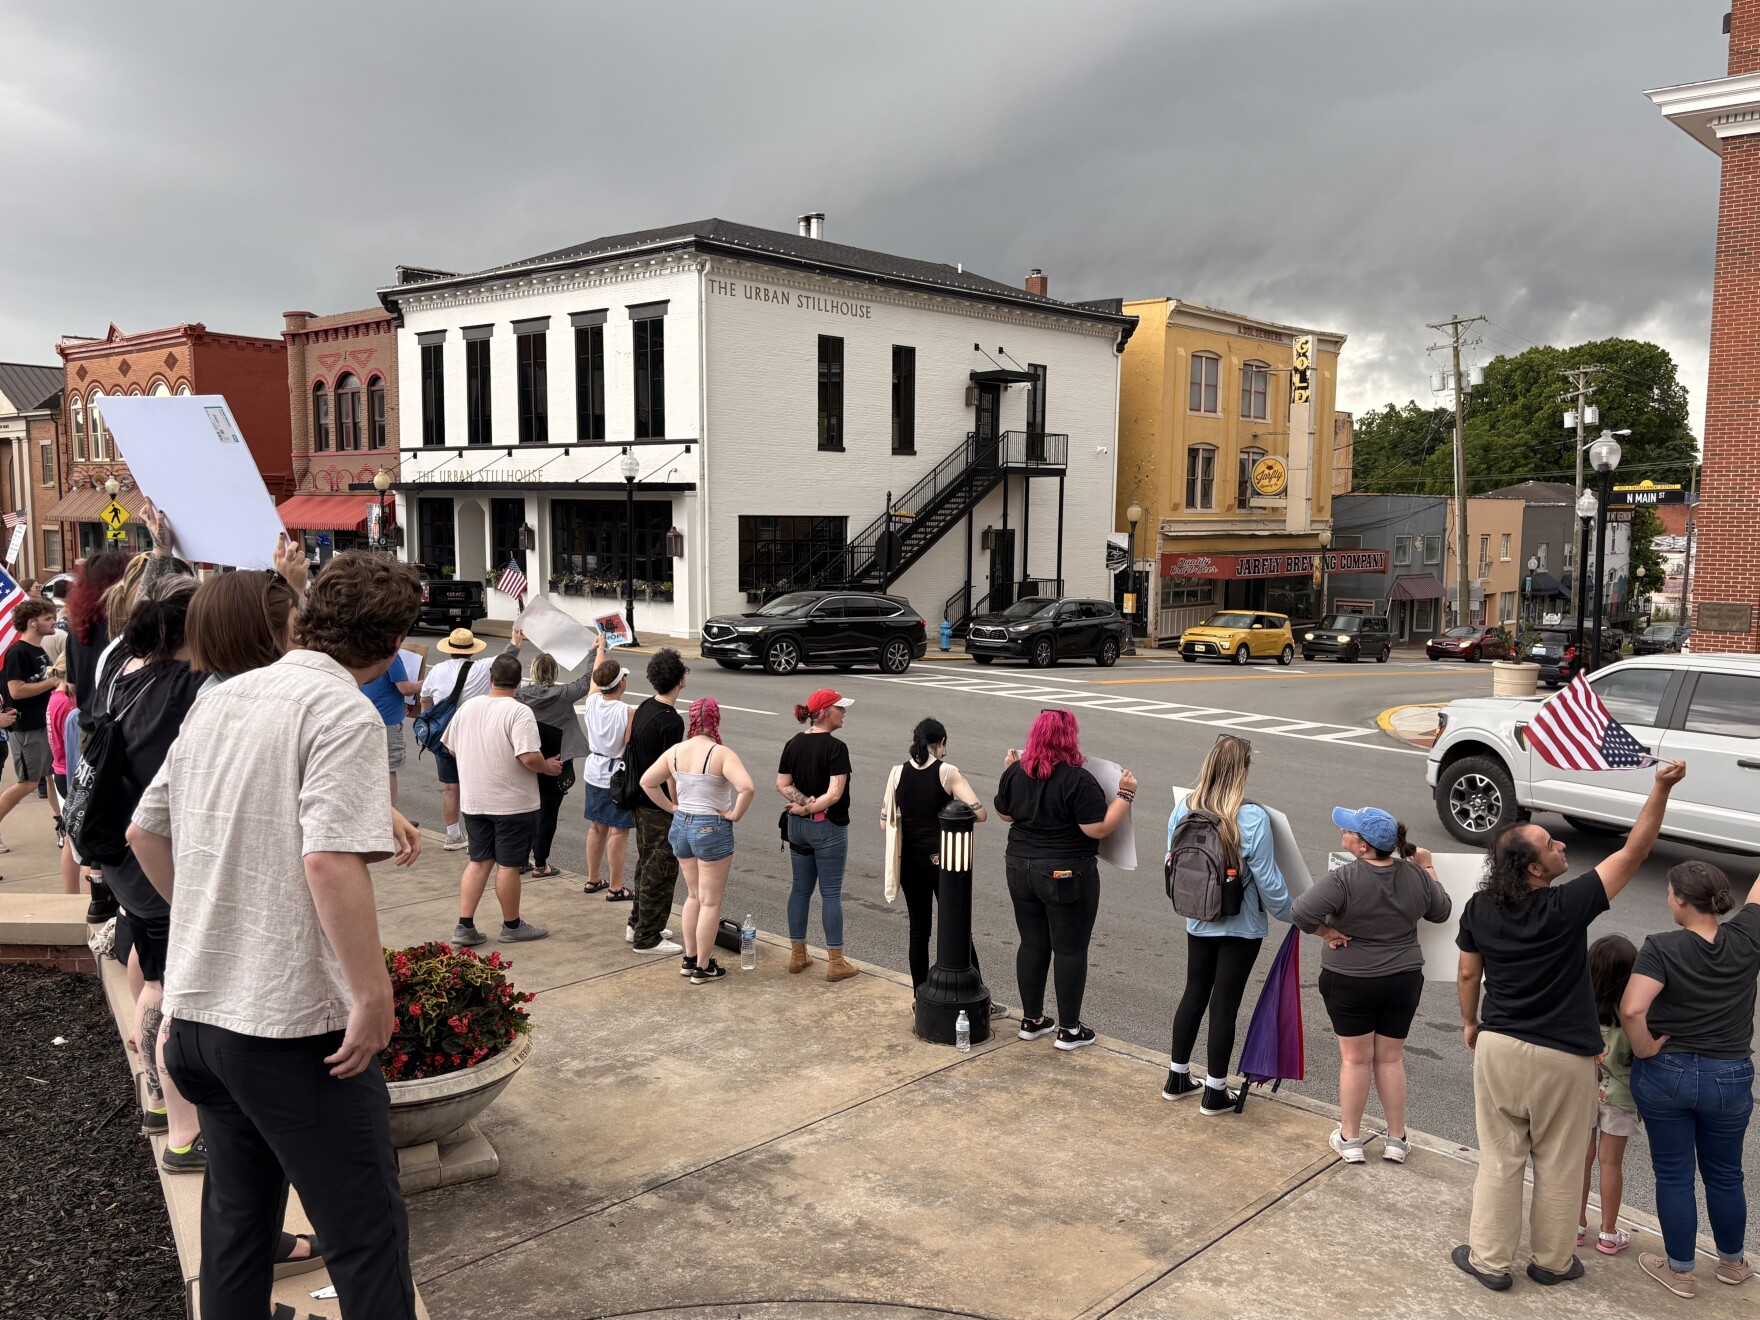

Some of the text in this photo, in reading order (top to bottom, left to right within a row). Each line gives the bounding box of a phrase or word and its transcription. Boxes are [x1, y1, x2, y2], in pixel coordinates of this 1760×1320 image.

[708, 279, 871, 319] THE URBAN STILLHOUSE
[1295, 340, 1309, 403] GOLD
[417, 469, 543, 482] THE URBAN STILLHOUSE
[1256, 469, 1283, 485] Jarfly
[1627, 493, 1633, 503] N
[1635, 493, 1656, 503] MAIN
[1177, 557, 1211, 567] Quality
[1236, 553, 1386, 577] JARFLY BREWNG COMPANY
